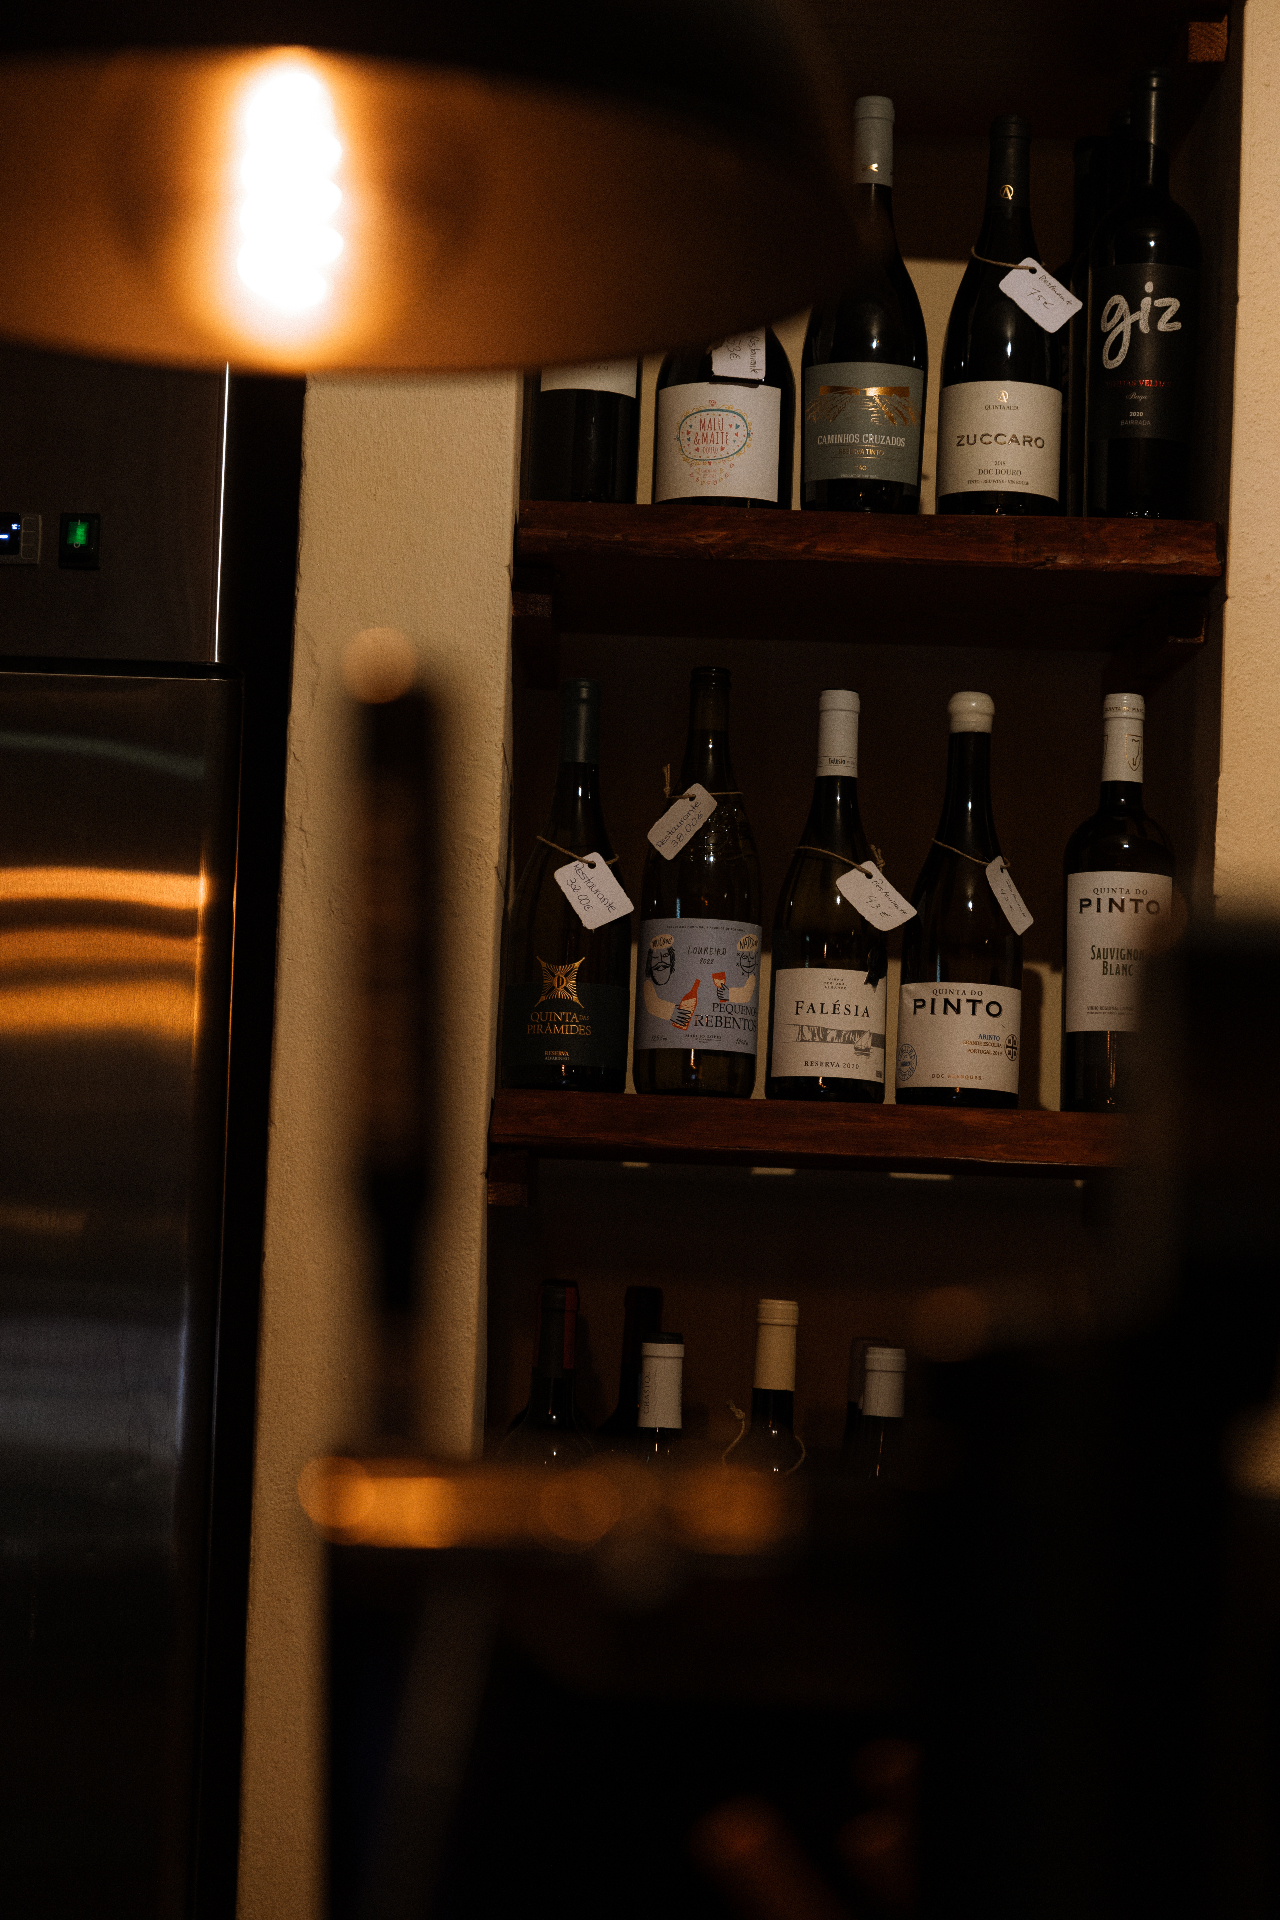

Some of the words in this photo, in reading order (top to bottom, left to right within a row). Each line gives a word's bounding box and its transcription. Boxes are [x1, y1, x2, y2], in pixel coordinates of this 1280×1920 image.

[1101, 281, 1182, 370] giz
[699, 417, 724, 431] MALU
[817, 433, 860, 445] CAMINHOS
[862, 433, 906, 448] CRUZADOS
[956, 433, 1045, 449] ZUCCARO
[865, 448, 885, 456] TINTO
[978, 468, 994, 476] DOC
[995, 468, 1022, 476] DOURO
[573, 863, 617, 914] Restaurante
[1092, 887, 1131, 895] QUINTA
[1079, 897, 1161, 915] PINTO
[687, 946, 727, 957] LOUREIRO
[1102, 961, 1134, 976] BLANC
[932, 988, 967, 996] QUINTA
[794, 1000, 870, 1018] FALÉSIA
[913, 998, 1002, 1018] PINTO
[530, 1011, 580, 1022] QUINTA
[693, 1014, 757, 1032] REBENTOS
[527, 1022, 592, 1036] PIRÂMIDES
[978, 1033, 1001, 1041] ARINTO
[804, 1060, 840, 1068] RESERVA
